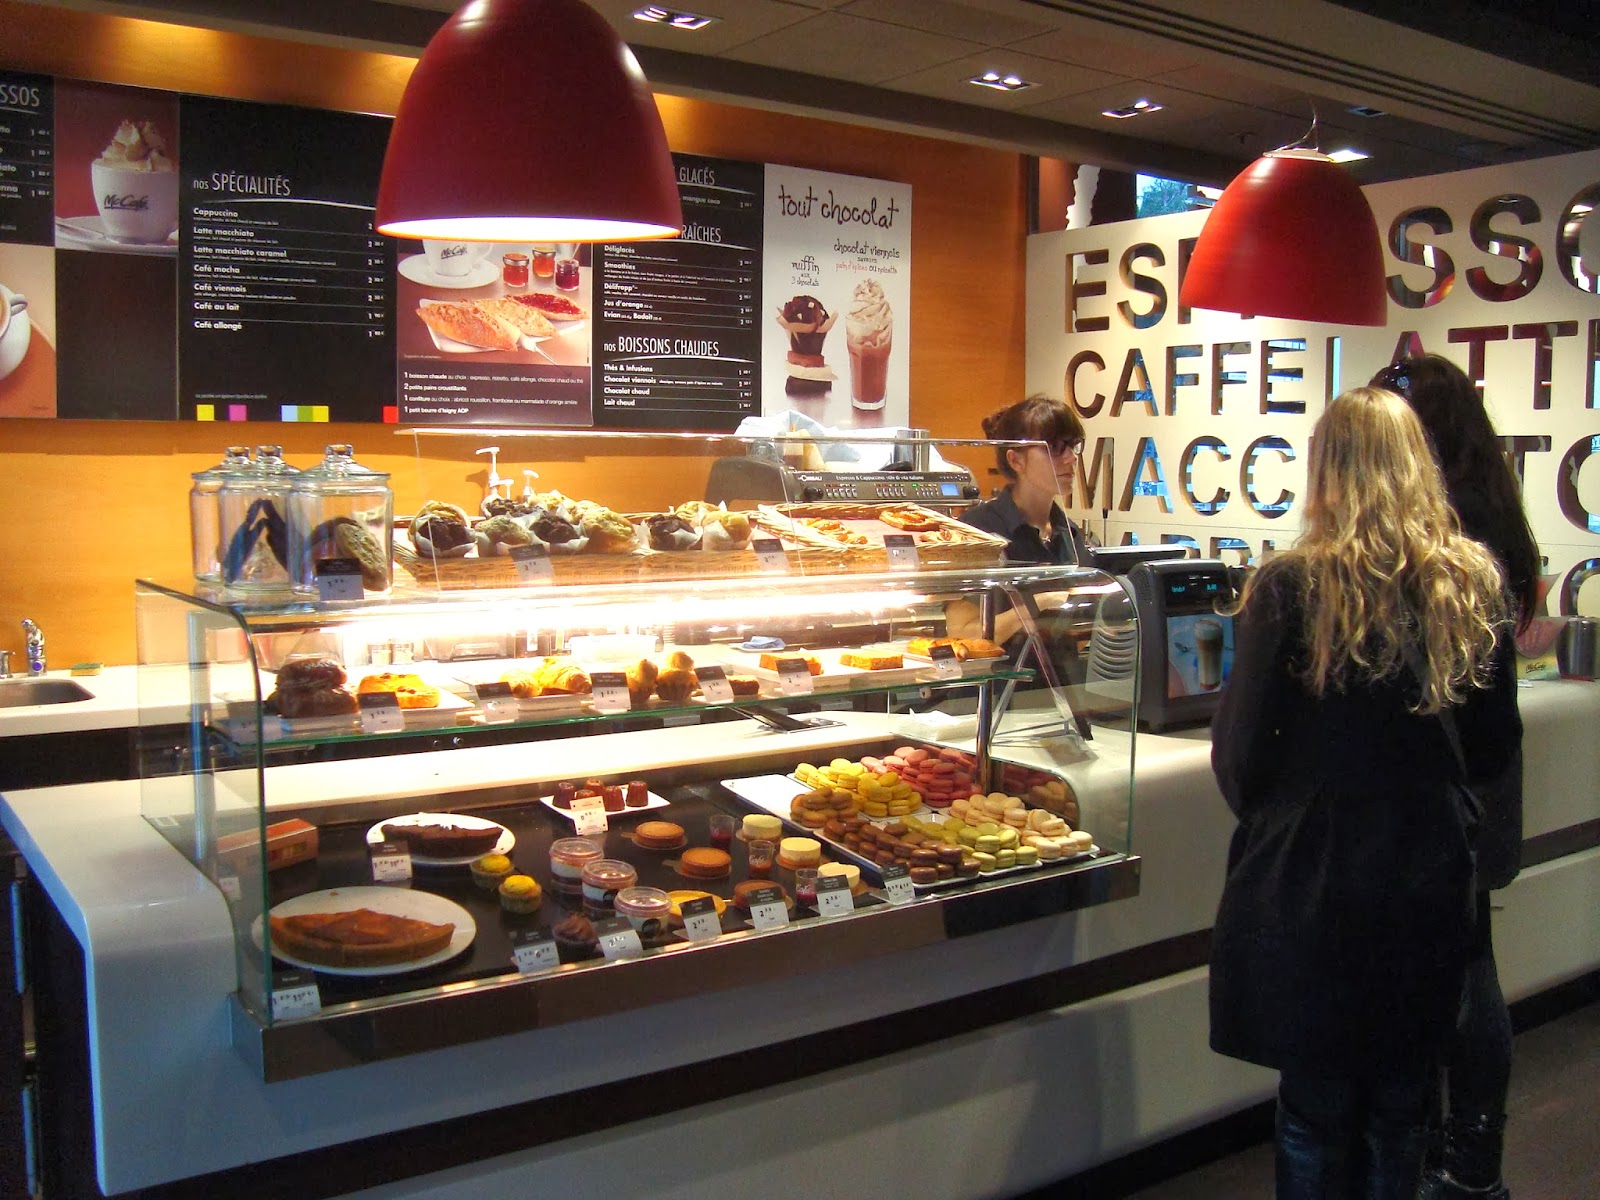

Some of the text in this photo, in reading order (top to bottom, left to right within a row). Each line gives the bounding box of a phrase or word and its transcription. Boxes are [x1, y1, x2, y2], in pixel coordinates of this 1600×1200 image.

[679, 166, 715, 186] GLACÉS
[193, 170, 291, 196] nos SPÉCIALITÉS
[778, 184, 899, 229] tout chocolat
[193, 207, 239, 218] Cappuccino
[193, 226, 213, 235] Latte
[215, 229, 255, 238] macchiato
[680, 222, 722, 243] RAÎCHES
[193, 245, 213, 254] Latte
[215, 247, 255, 256] macchiato
[256, 249, 287, 258] caramel
[833, 238, 870, 255] chocolat
[193, 264, 212, 273] Café
[214, 266, 240, 274] mocha
[604, 261, 636, 270] Smoothies
[193, 283, 212, 291] Café
[214, 284, 247, 293] viennois
[194, 302, 213, 310] Café
[226, 303, 240, 312] lait
[604, 299, 614, 307] Jus
[615, 300, 644, 309] d'orange
[194, 321, 213, 329] Café
[213, 321, 242, 332] allongé
[603, 336, 720, 357] nos BOISSONS CHAUDES
[603, 363, 618, 372] Thés
[626, 364, 653, 373] Infusions
[1064, 319, 1600, 419] CAFFE LTT
[603, 375, 631, 384] Chocolat
[631, 376, 657, 384] viennois
[603, 387, 631, 395] Chocolat
[631, 388, 650, 396] chaud
[603, 398, 616, 407] Lait
[616, 399, 636, 407] chaud
